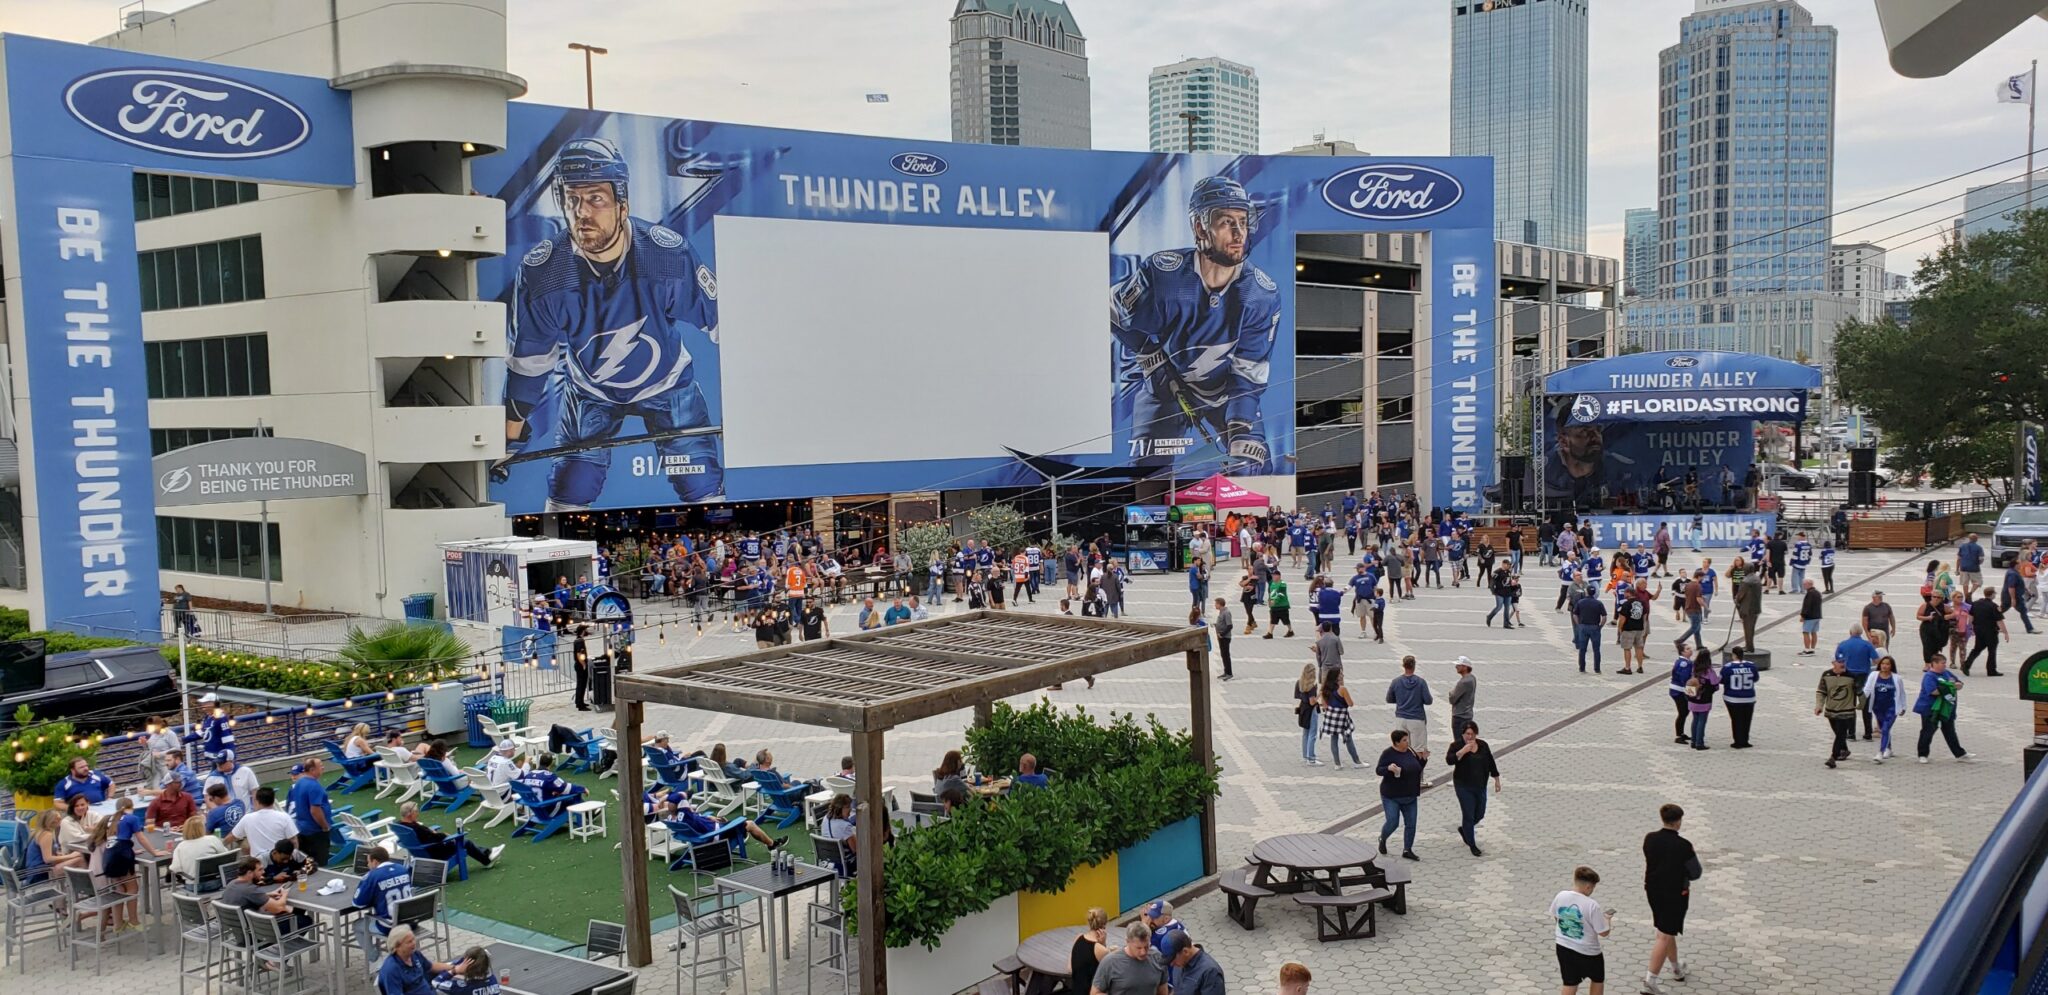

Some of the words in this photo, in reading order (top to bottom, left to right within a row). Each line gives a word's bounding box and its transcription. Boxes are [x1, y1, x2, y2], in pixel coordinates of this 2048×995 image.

[118, 80, 264, 147] Ford
[902, 154, 937, 173] Ford
[779, 174, 940, 215] THUNDER
[956, 185, 1056, 218] ALLEY
[1350, 173, 1435, 210] Ford
[57, 207, 103, 262] BE
[1452, 264, 1475, 298] BE
[63, 281, 112, 368] THE
[1452, 309, 1477, 364] THE
[1671, 357, 1694, 368] Ford
[1609, 374, 1693, 388] THUNDER
[1700, 372, 1757, 387] ALLEY
[1606, 397, 1800, 414] #FLORIDASTRONG
[1452, 375, 1477, 507] THUNDER
[1646, 431, 1740, 449] THUNDER
[668, 456, 688, 464] ERIK
[1662, 449, 1724, 466] ALLEY
[198, 463, 252, 478] THANK
[255, 461, 284, 475] YOU
[288, 459, 317, 473] FOR
[71, 387, 130, 598] THUNDER
[200, 479, 247, 494] BEING
[251, 477, 280, 491] THE
[282, 474, 354, 489] THUNDER!
[1612, 522, 1654, 542] THE
